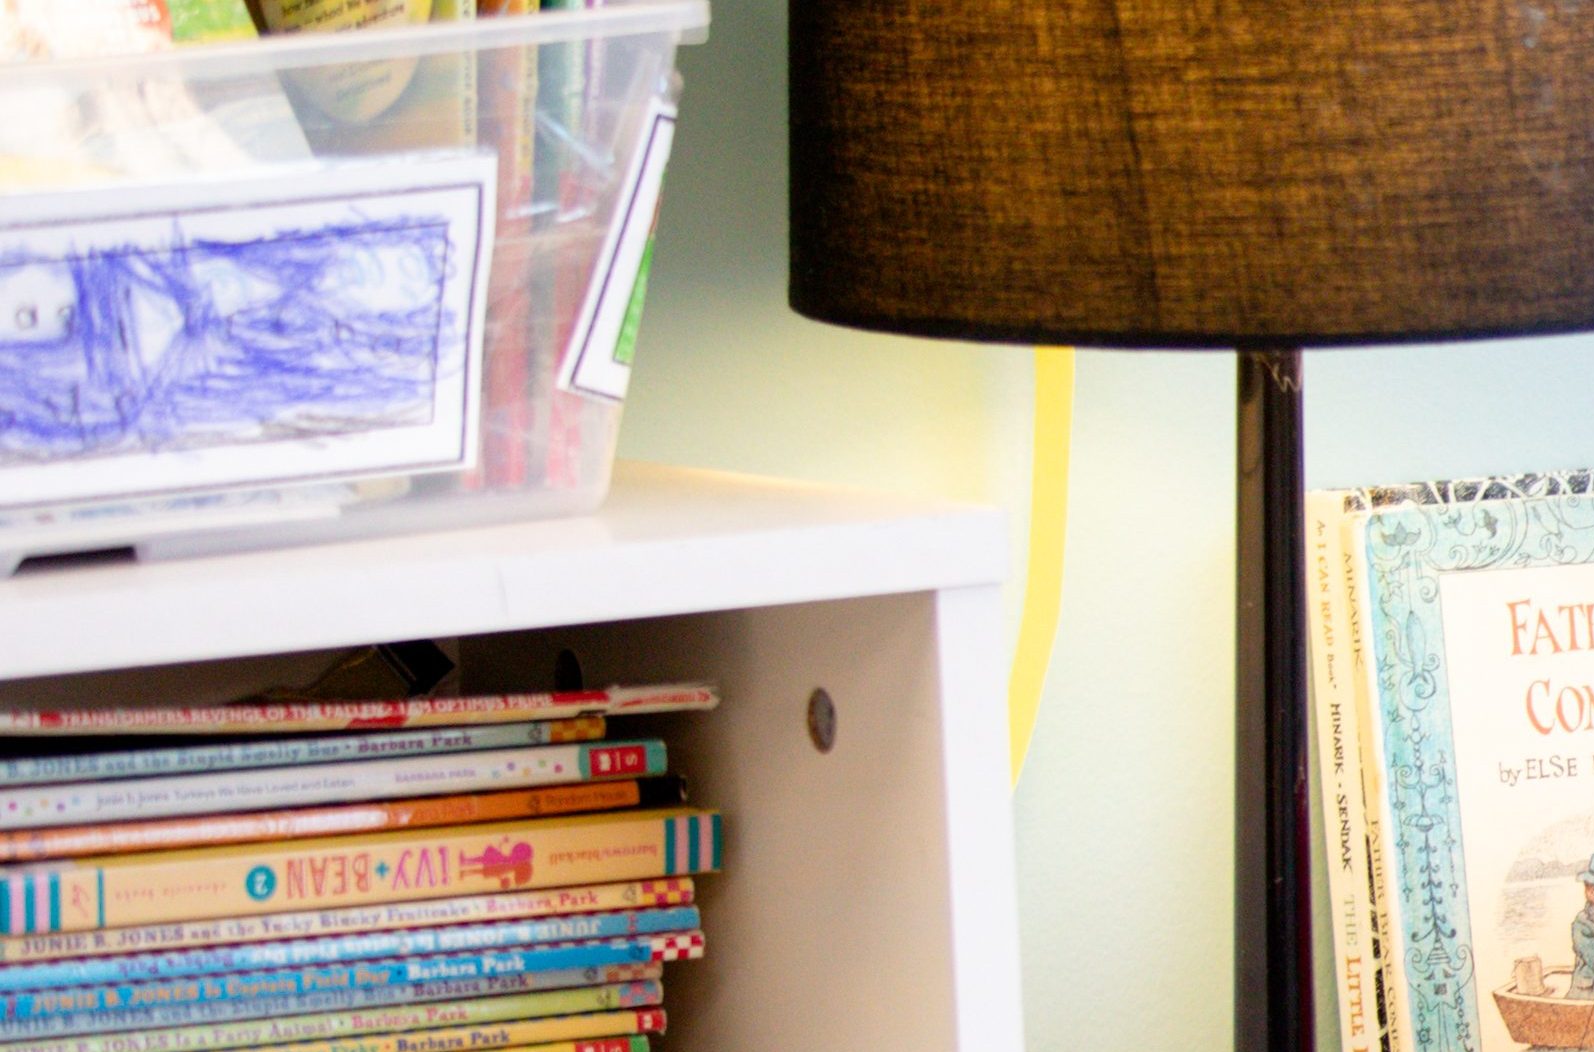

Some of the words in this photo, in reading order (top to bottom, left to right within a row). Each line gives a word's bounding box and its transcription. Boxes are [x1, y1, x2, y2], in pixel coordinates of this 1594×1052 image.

[1330, 703, 1345, 774] MINARIK
[1498, 762, 1522, 786] by
[1526, 756, 1578, 780] ELSE
[1336, 791, 1354, 875] SENDAK
[286, 852, 371, 899] BEAN
[1343, 894, 1358, 947] THE
[1345, 955, 1364, 1038] LITTLE
